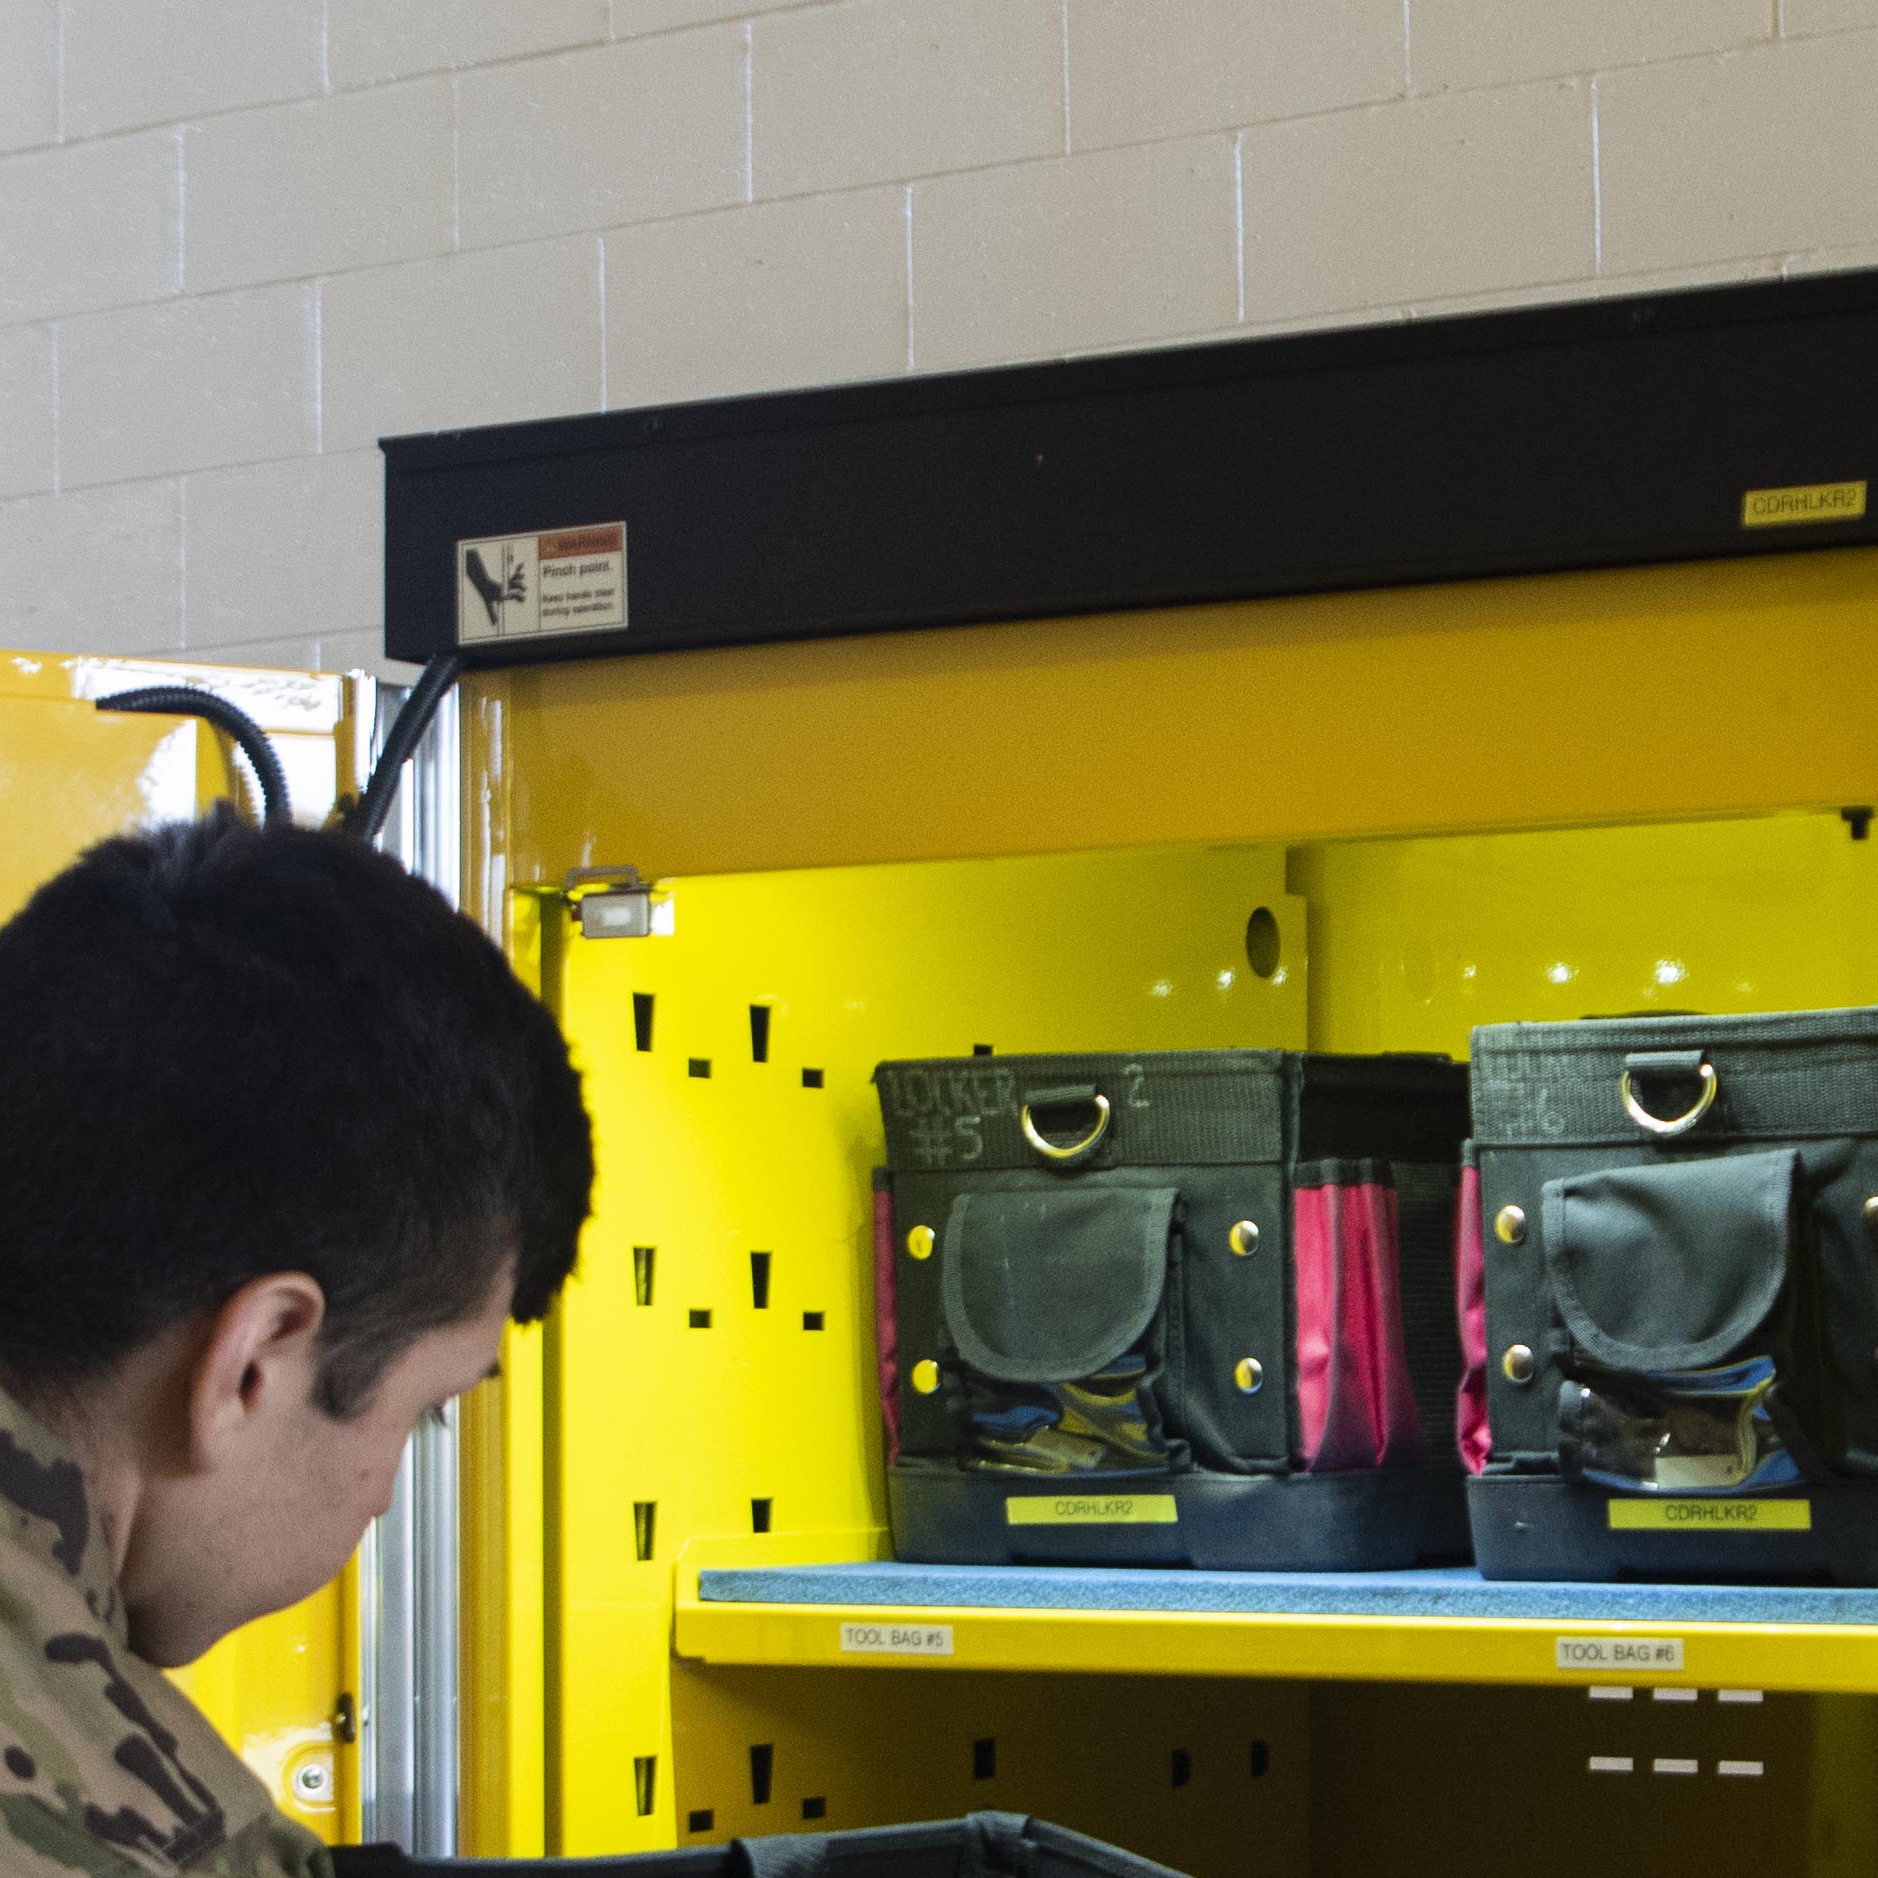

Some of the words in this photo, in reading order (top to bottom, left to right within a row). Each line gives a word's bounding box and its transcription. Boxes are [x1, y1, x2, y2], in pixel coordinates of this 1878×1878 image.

[1753, 488, 1857, 515] CDRHLKR2
[543, 565, 577, 577] Pinch
[909, 1115, 984, 1165] #5
[1055, 1500, 1133, 1516] CDRHLKR2
[1664, 1503, 1758, 1521] CDRHLKR2
[845, 1627, 885, 1645] TOOL
[891, 1629, 922, 1646] BAG
[926, 1631, 944, 1647] #5
[1561, 1642, 1607, 1661] TOOL
[1613, 1644, 1650, 1661] BAG
[1655, 1644, 1675, 1662] #6
